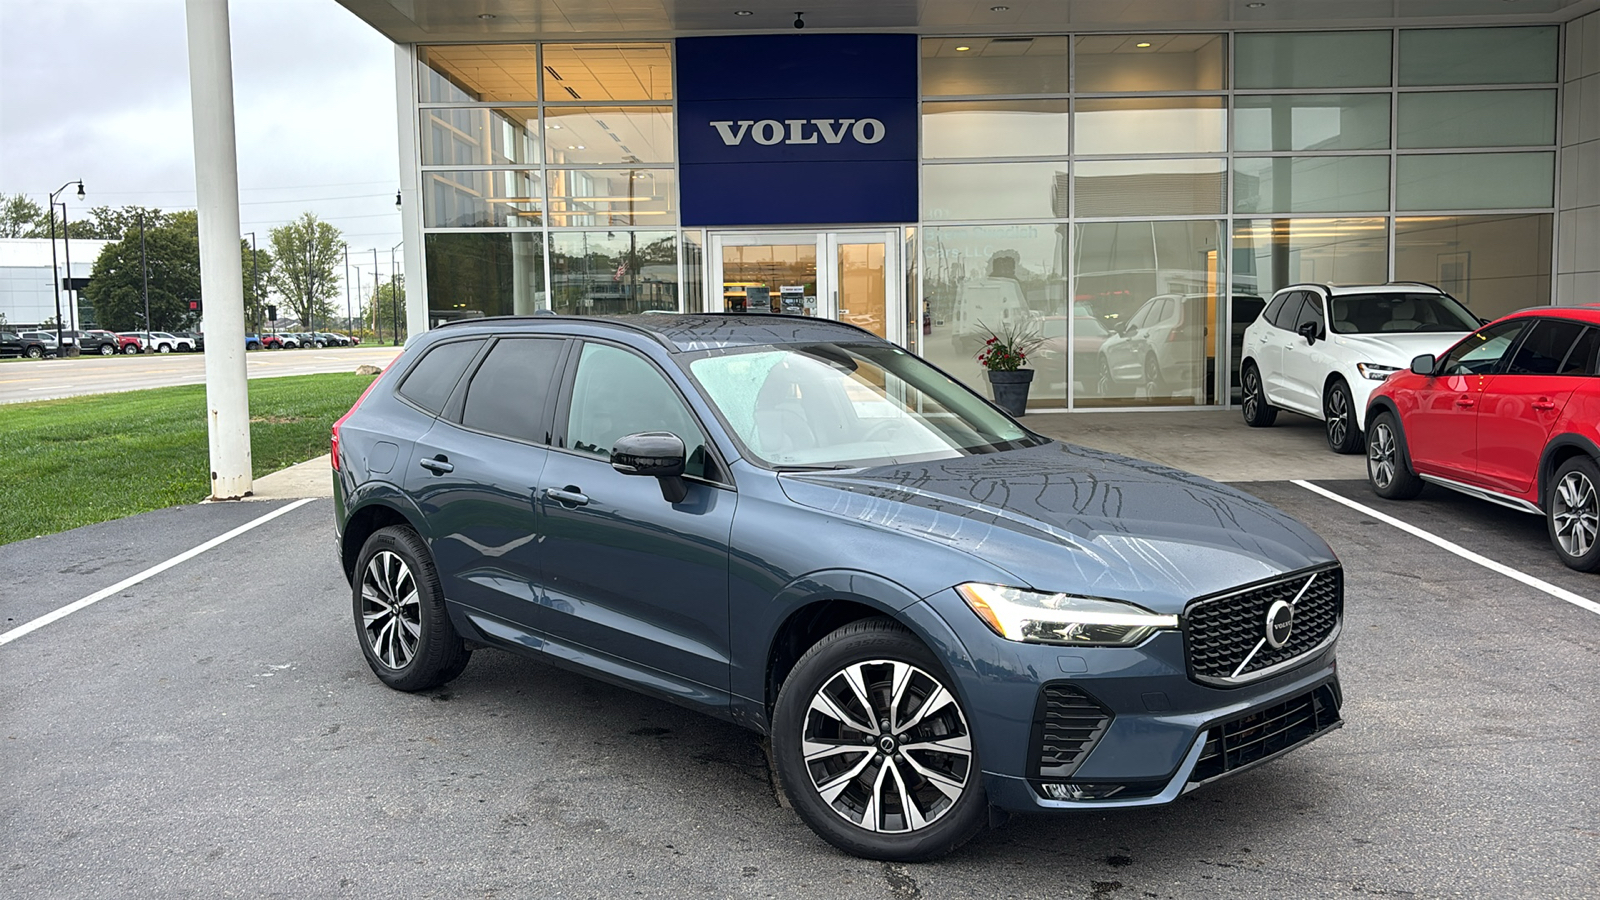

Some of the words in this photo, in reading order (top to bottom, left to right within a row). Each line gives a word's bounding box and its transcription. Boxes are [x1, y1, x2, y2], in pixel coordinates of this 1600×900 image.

[710, 118, 885, 145] VOLVO
[973, 226, 1038, 240] Swedish
[925, 246, 960, 258] Cars
[965, 245, 993, 257] LLC
